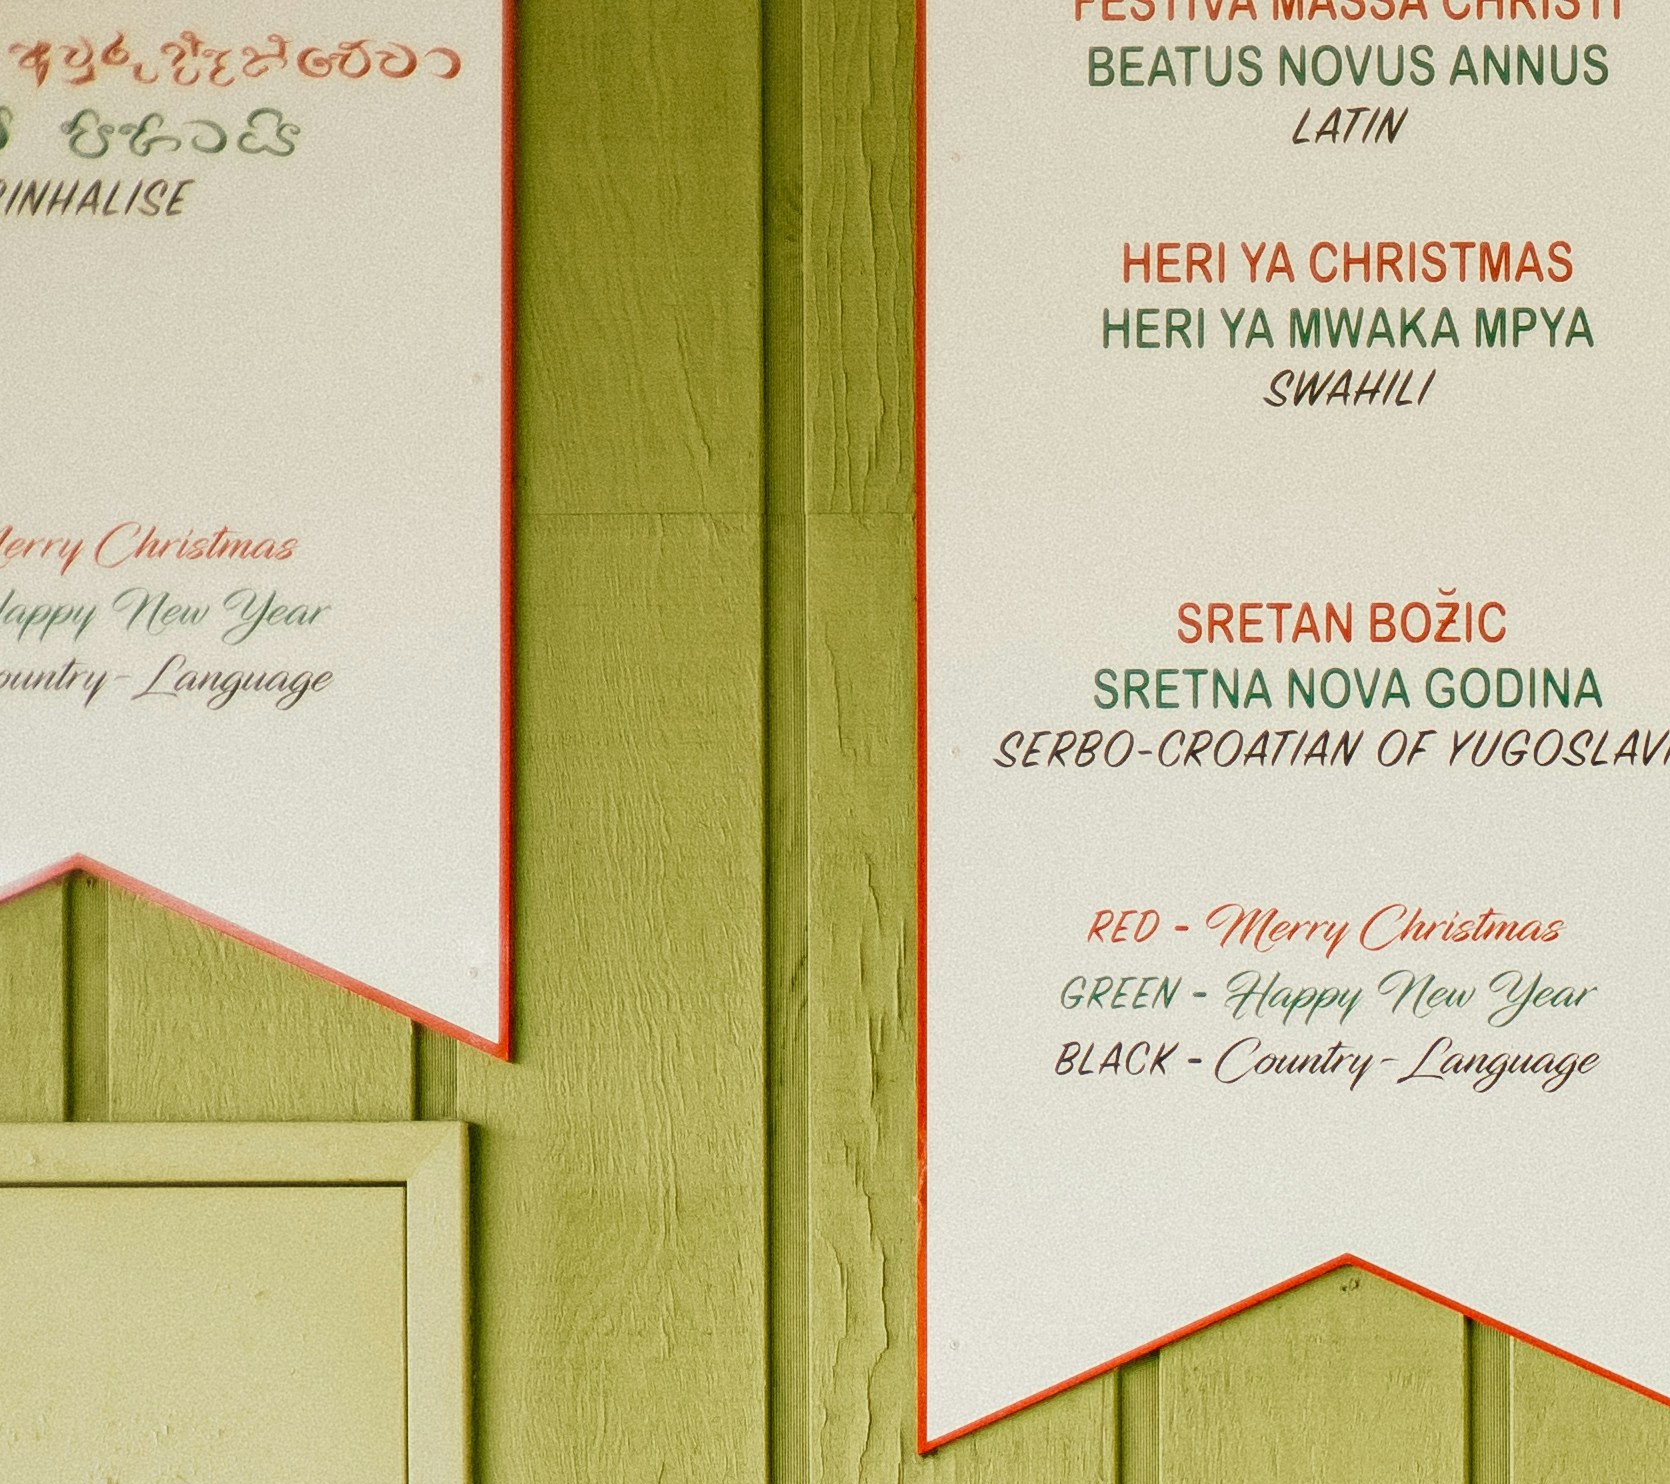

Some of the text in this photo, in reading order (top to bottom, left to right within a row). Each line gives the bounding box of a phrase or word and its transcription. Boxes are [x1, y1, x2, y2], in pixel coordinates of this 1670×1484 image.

[1089, 45, 1610, 87] BEATUS NOVUS ANNUS
[1292, 107, 1408, 145] LATIN
[1122, 241, 1574, 284] HERI YA CHRISTMAS
[1102, 307, 1595, 349] HERI YA MWAKA MPYA
[1263, 370, 1436, 407] SWAHILI
[0, 521, 300, 576] erry Christmas
[0, 587, 332, 646] appy New Year
[1178, 602, 1351, 644] SRETAN
[1093, 667, 1603, 709] SRETNA NOVA GODINA
[993, 729, 1361, 768] SERBO-CROATIAN
[1378, 729, 1438, 768] OF
[1087, 910, 1161, 944] RED
[1205, 903, 1350, 958] Merry
[1360, 903, 1565, 955] Christmas
[1060, 976, 1181, 1011] GREEN
[1225, 970, 1364, 1025] Happy
[1376, 970, 1476, 1016] New
[1487, 970, 1598, 1028] Year
[1054, 1042, 1172, 1076] BLACK
